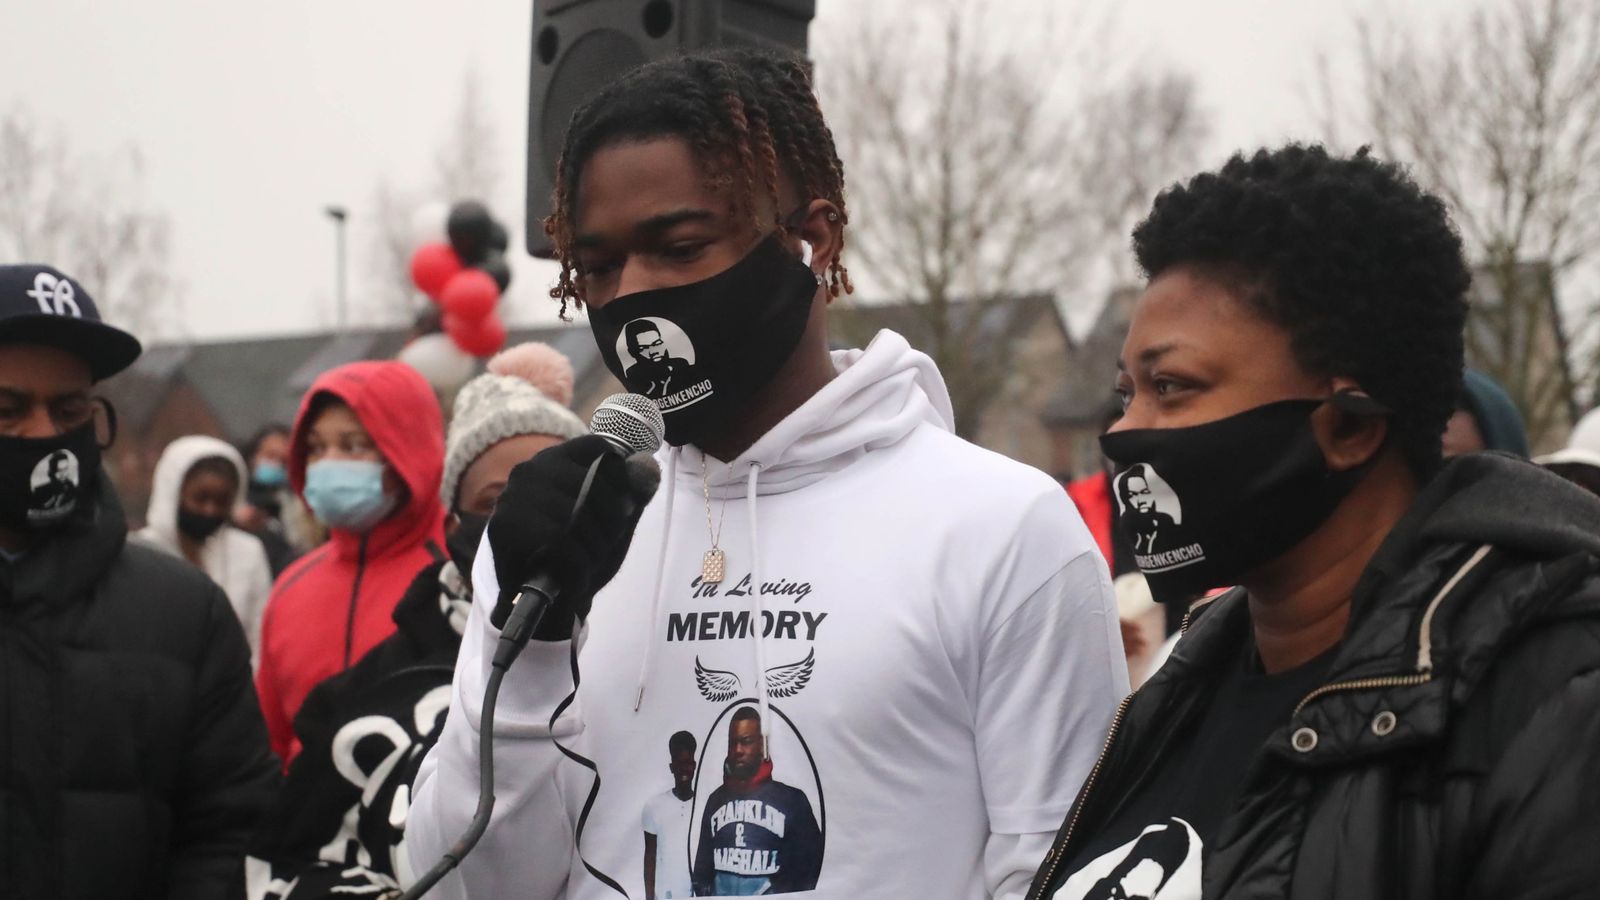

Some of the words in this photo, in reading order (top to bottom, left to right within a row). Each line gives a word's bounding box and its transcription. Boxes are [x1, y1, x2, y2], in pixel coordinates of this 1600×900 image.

[691, 575, 718, 599] In
[667, 610, 828, 641] MEMORY
[711, 799, 786, 838] FRANKLIN
[735, 823, 746, 847] &
[713, 847, 781, 875] MARSHALL
